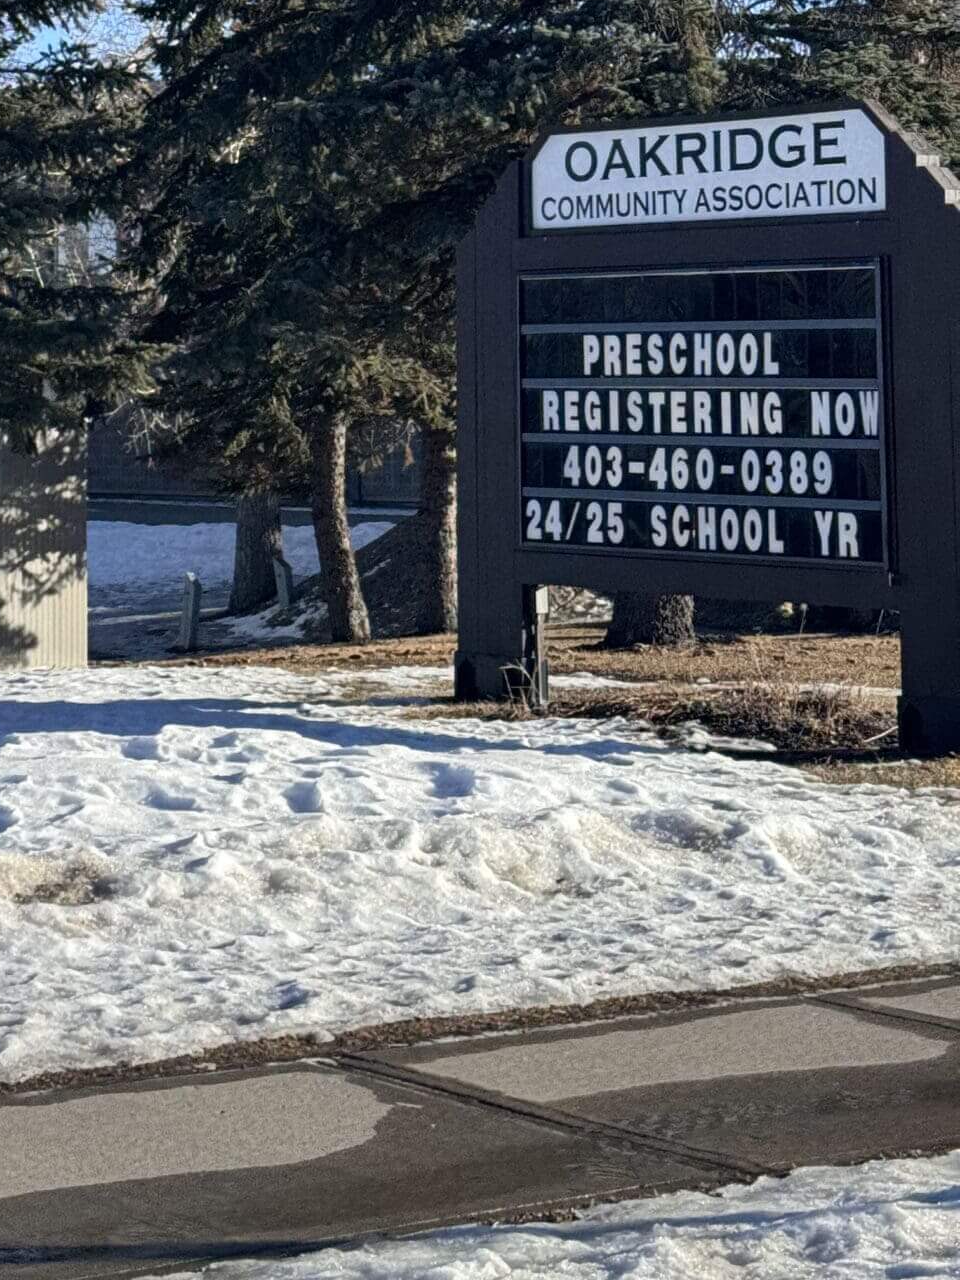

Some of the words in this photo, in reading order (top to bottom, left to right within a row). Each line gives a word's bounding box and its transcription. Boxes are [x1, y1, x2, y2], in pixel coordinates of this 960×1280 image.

[564, 119, 847, 182] OAKRIDGE
[541, 189, 687, 222] COMMUNITY
[694, 177, 877, 214] ASSOCIATION
[583, 332, 780, 376] PRESCHOOL
[542, 390, 783, 435] REGISTERING
[811, 390, 880, 436] NOW
[563, 445, 832, 494] 403-460-0389
[526, 499, 625, 544] 24/25
[651, 504, 784, 554] SCHOOL
[814, 510, 859, 557] YR
